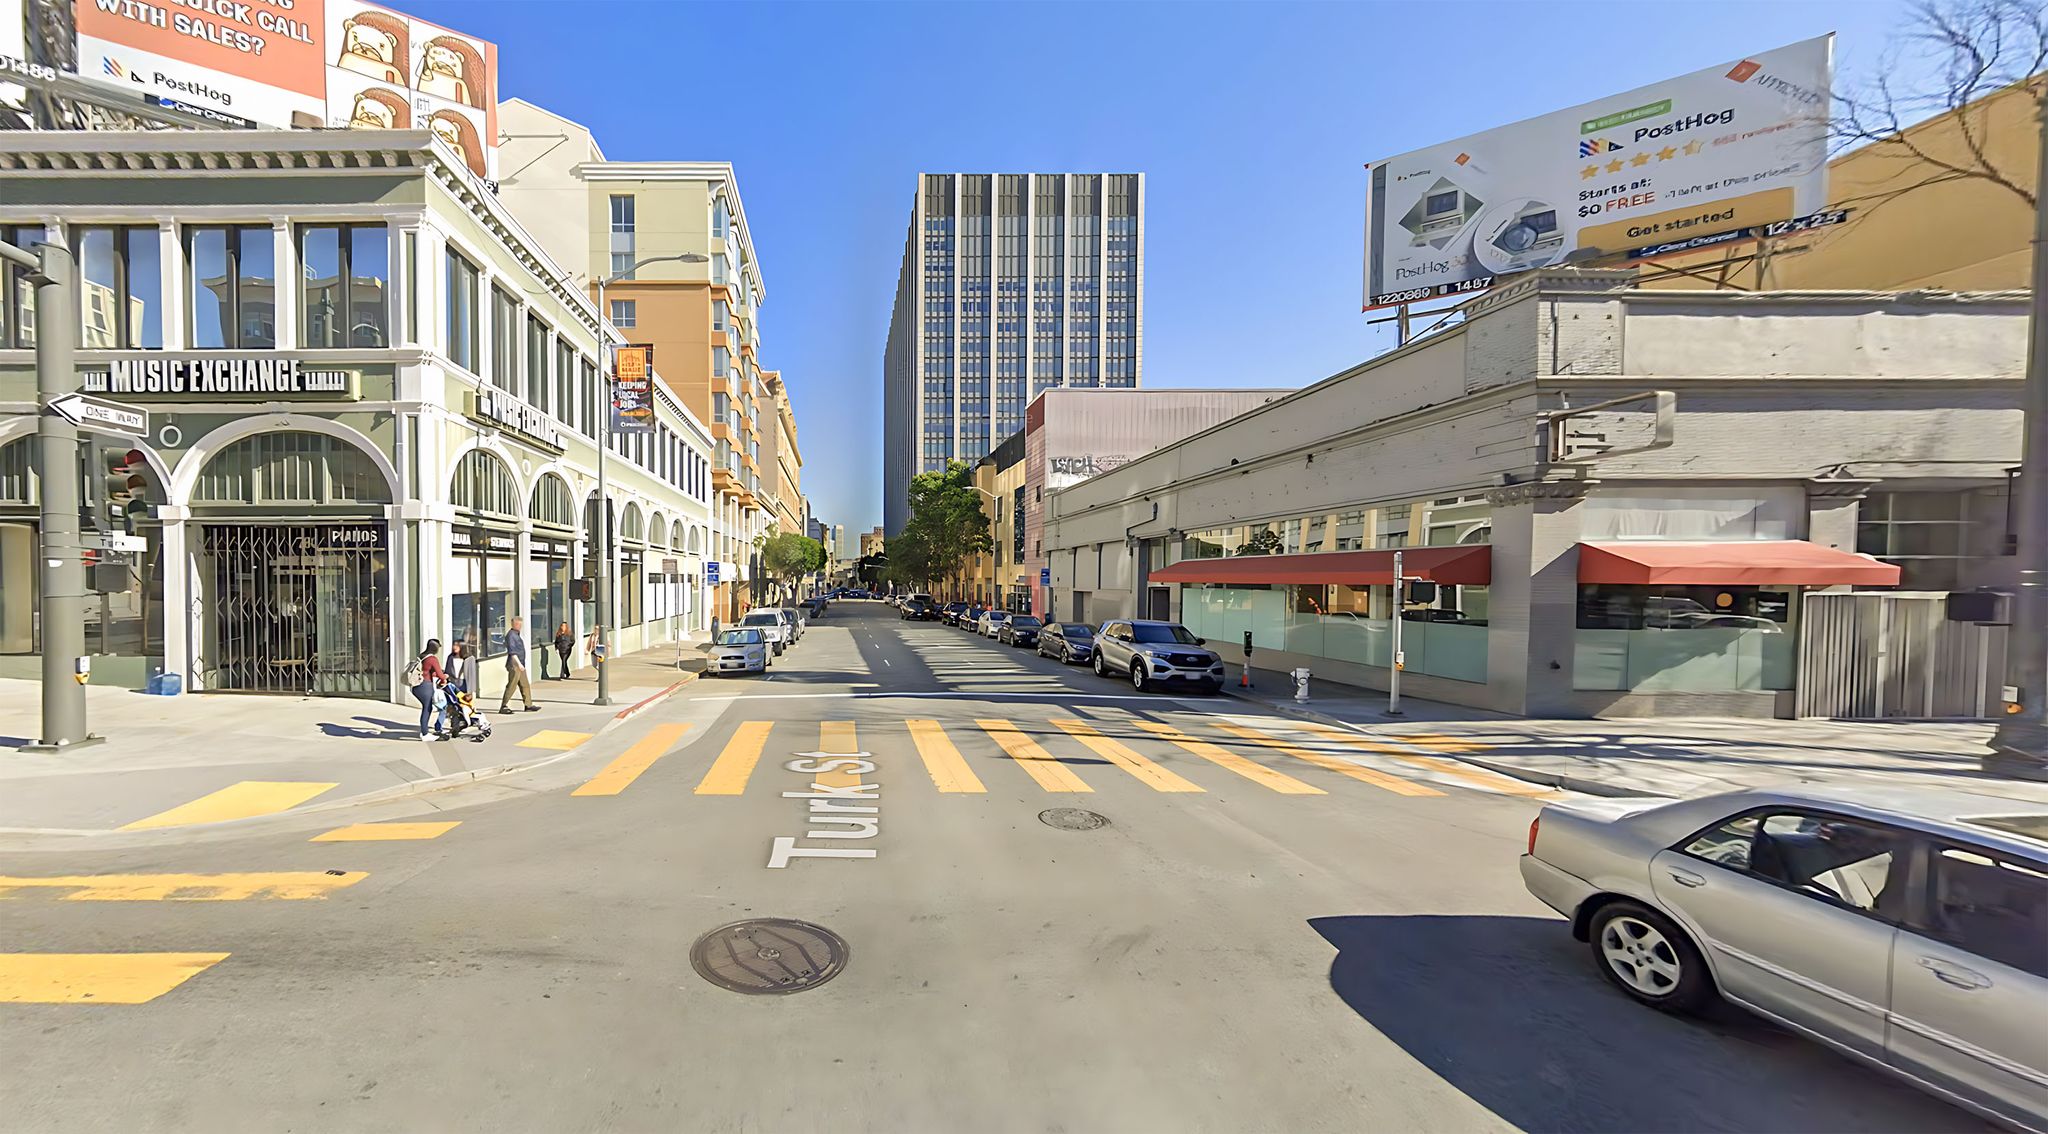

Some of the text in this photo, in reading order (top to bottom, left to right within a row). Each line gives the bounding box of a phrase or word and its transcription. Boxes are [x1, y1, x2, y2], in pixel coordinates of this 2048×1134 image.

[95, 0, 267, 56] WITH SALES?
[256, 11, 315, 45] CALL
[154, 71, 232, 105] PostHog
[1634, 107, 1736, 143] PostHog
[1577, 203, 1602, 218] $0
[1605, 191, 1656, 212] FREE
[1578, 184, 1627, 201] Starts
[1664, 208, 1735, 231] started
[1395, 260, 1451, 281] PostHog
[109, 359, 301, 393] MUSIC EXCHANGE
[86, 405, 141, 426] ONE WAY
